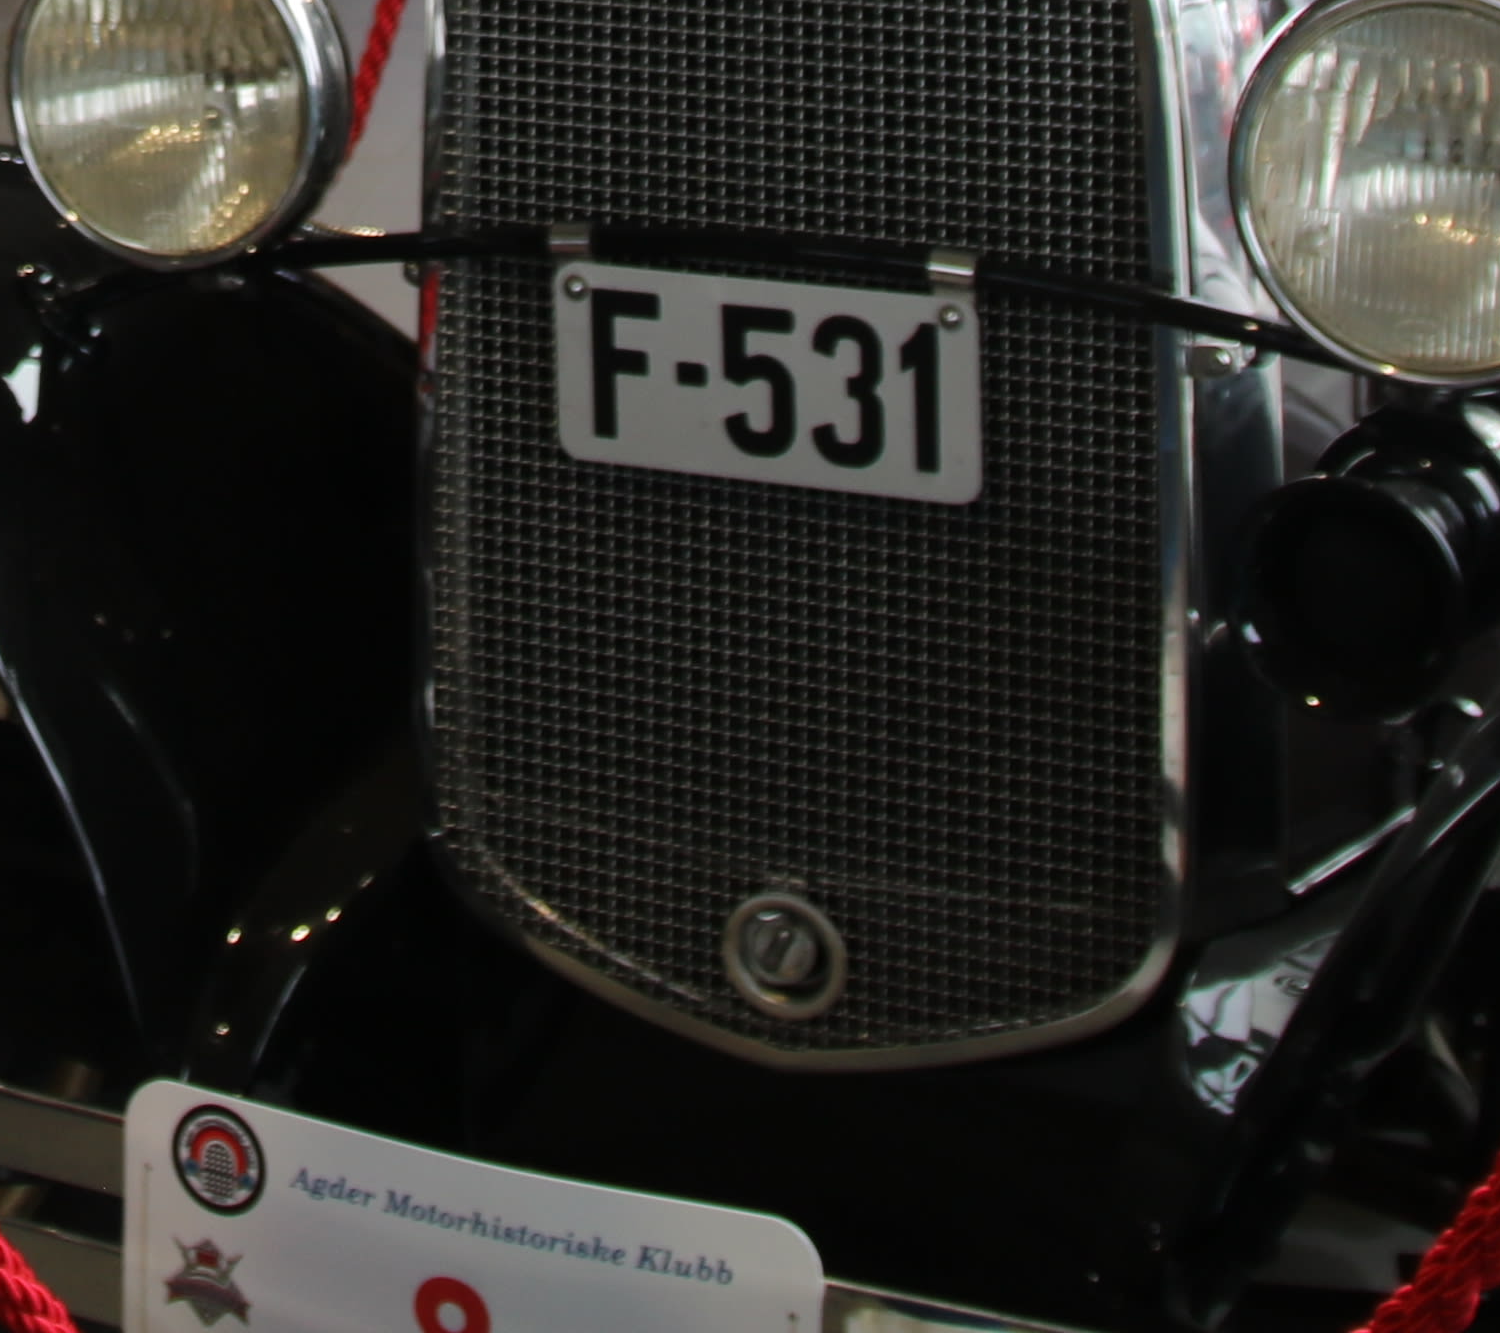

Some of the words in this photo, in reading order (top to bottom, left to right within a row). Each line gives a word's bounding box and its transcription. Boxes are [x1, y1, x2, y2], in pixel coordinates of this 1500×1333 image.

[591, 288, 941, 474] F-531
[289, 1166, 376, 1206] Agder
[383, 1188, 626, 1266] Motorhistoriske
[635, 1244, 734, 1286] Klubb
